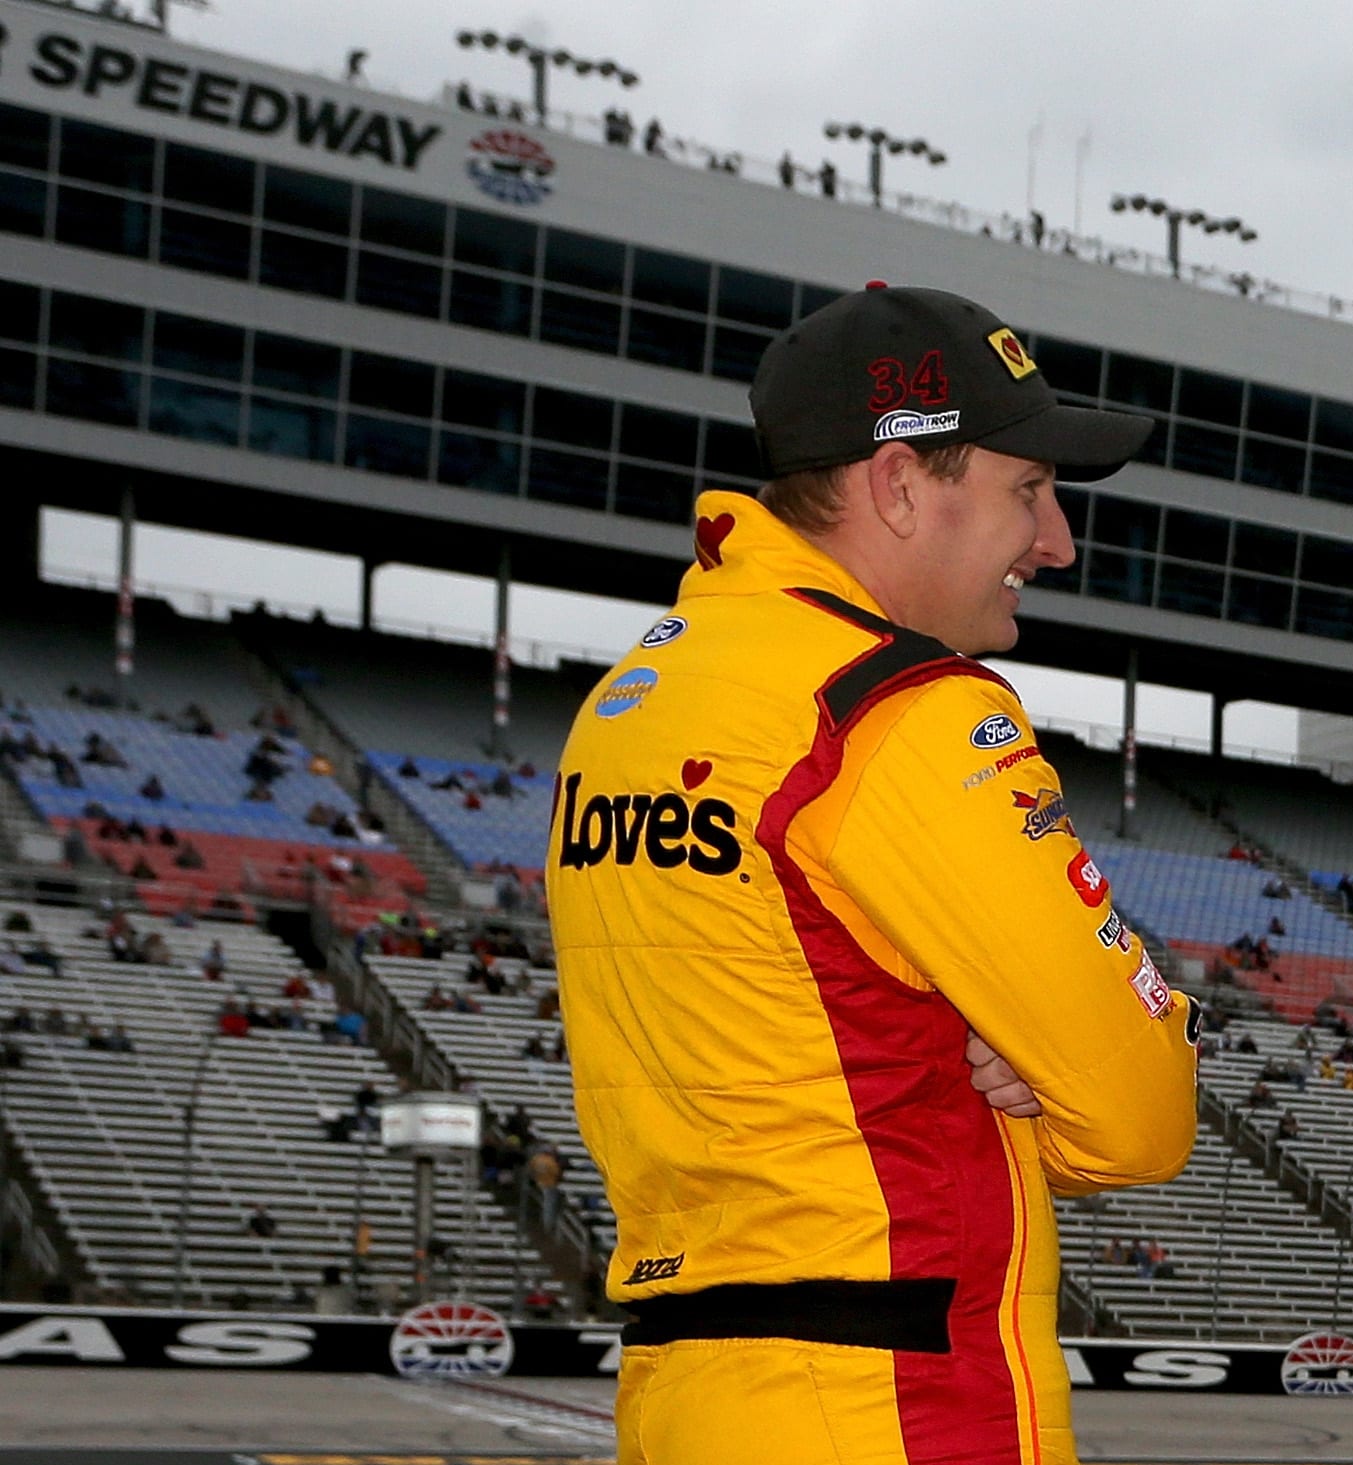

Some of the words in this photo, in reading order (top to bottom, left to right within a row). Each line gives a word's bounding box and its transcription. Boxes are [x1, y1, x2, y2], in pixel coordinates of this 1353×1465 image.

[29, 33, 443, 171] SPEEDWAY
[867, 350, 949, 413] 34
[985, 718, 1017, 744] Ford
